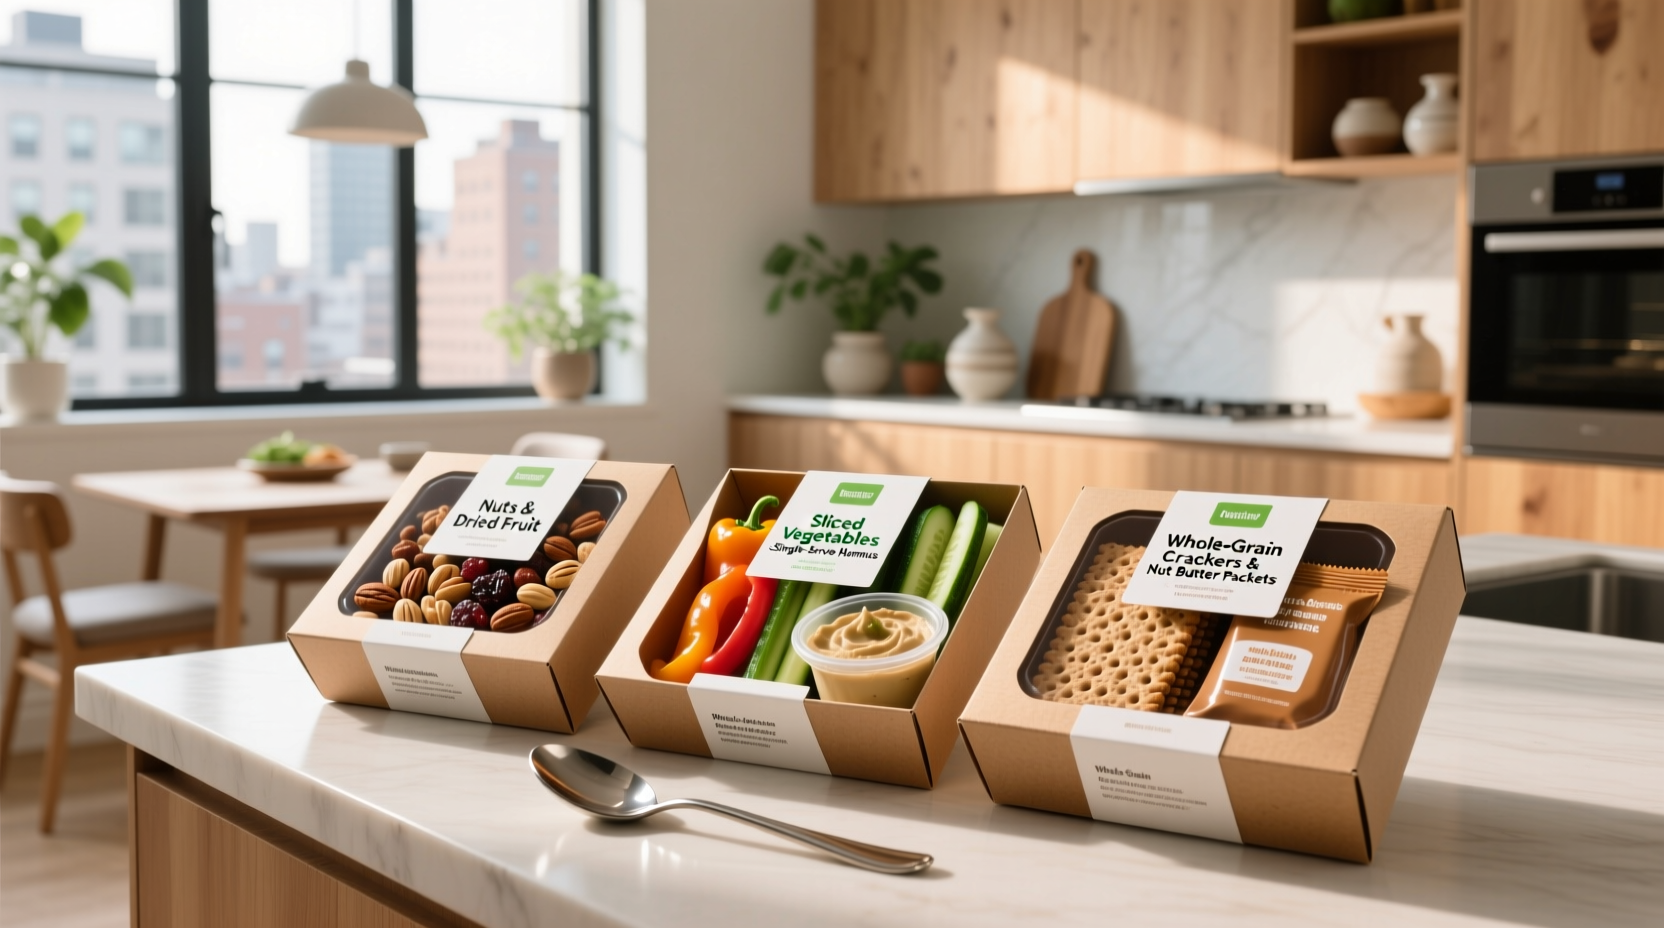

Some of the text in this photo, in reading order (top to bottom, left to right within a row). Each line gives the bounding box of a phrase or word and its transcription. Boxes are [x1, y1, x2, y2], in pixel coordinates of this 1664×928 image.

[479, 499, 534, 515] Nuts &
[453, 514, 542, 532] Dried Fruit
[811, 514, 866, 530] Sliced
[783, 526, 880, 546] Vegetables
[1167, 533, 1283, 557] Whole-Grain
[1162, 550, 1260, 570] Crackers &
[1146, 563, 1277, 585] Nut Butter Packets
